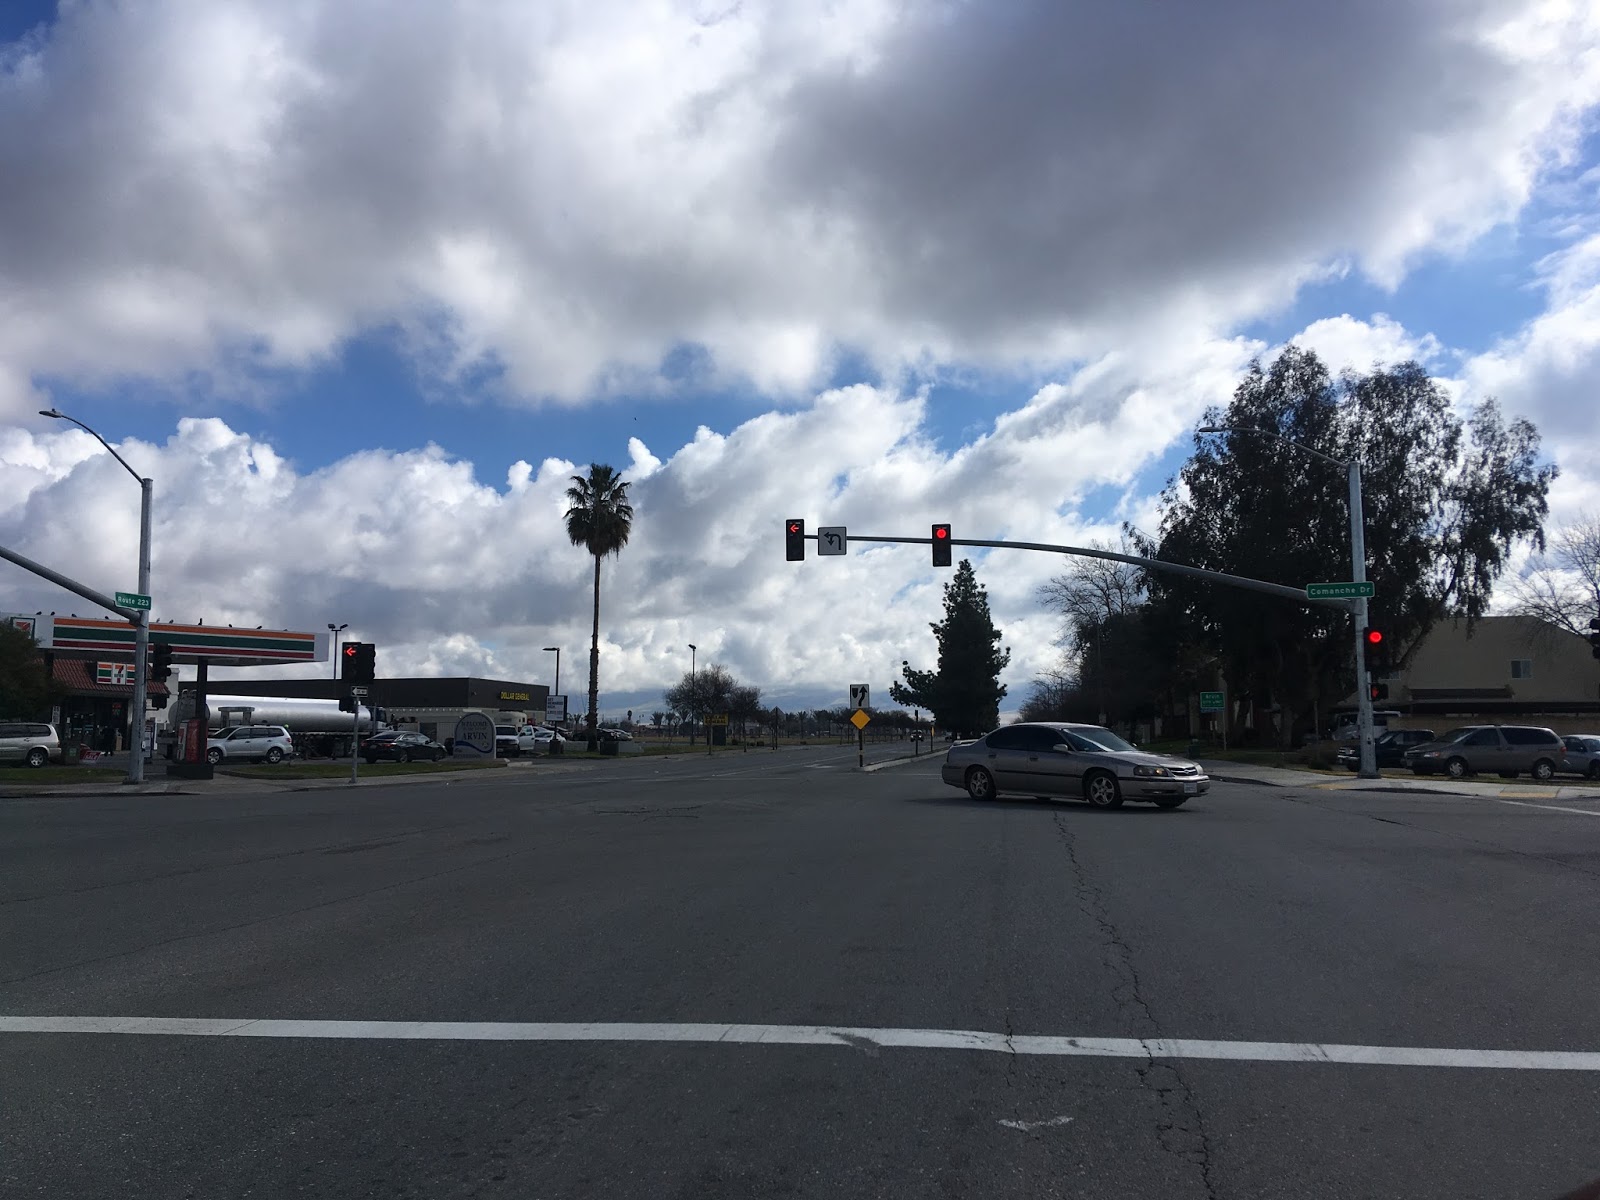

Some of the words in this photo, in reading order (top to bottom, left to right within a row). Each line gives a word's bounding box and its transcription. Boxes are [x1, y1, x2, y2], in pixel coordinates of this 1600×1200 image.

[1310, 587, 1356, 595] Comanche
[117, 596, 135, 604] Route
[501, 691, 514, 700] DOLLAR
[515, 692, 530, 701] GENERAL
[463, 732, 488, 740] ARVIN
